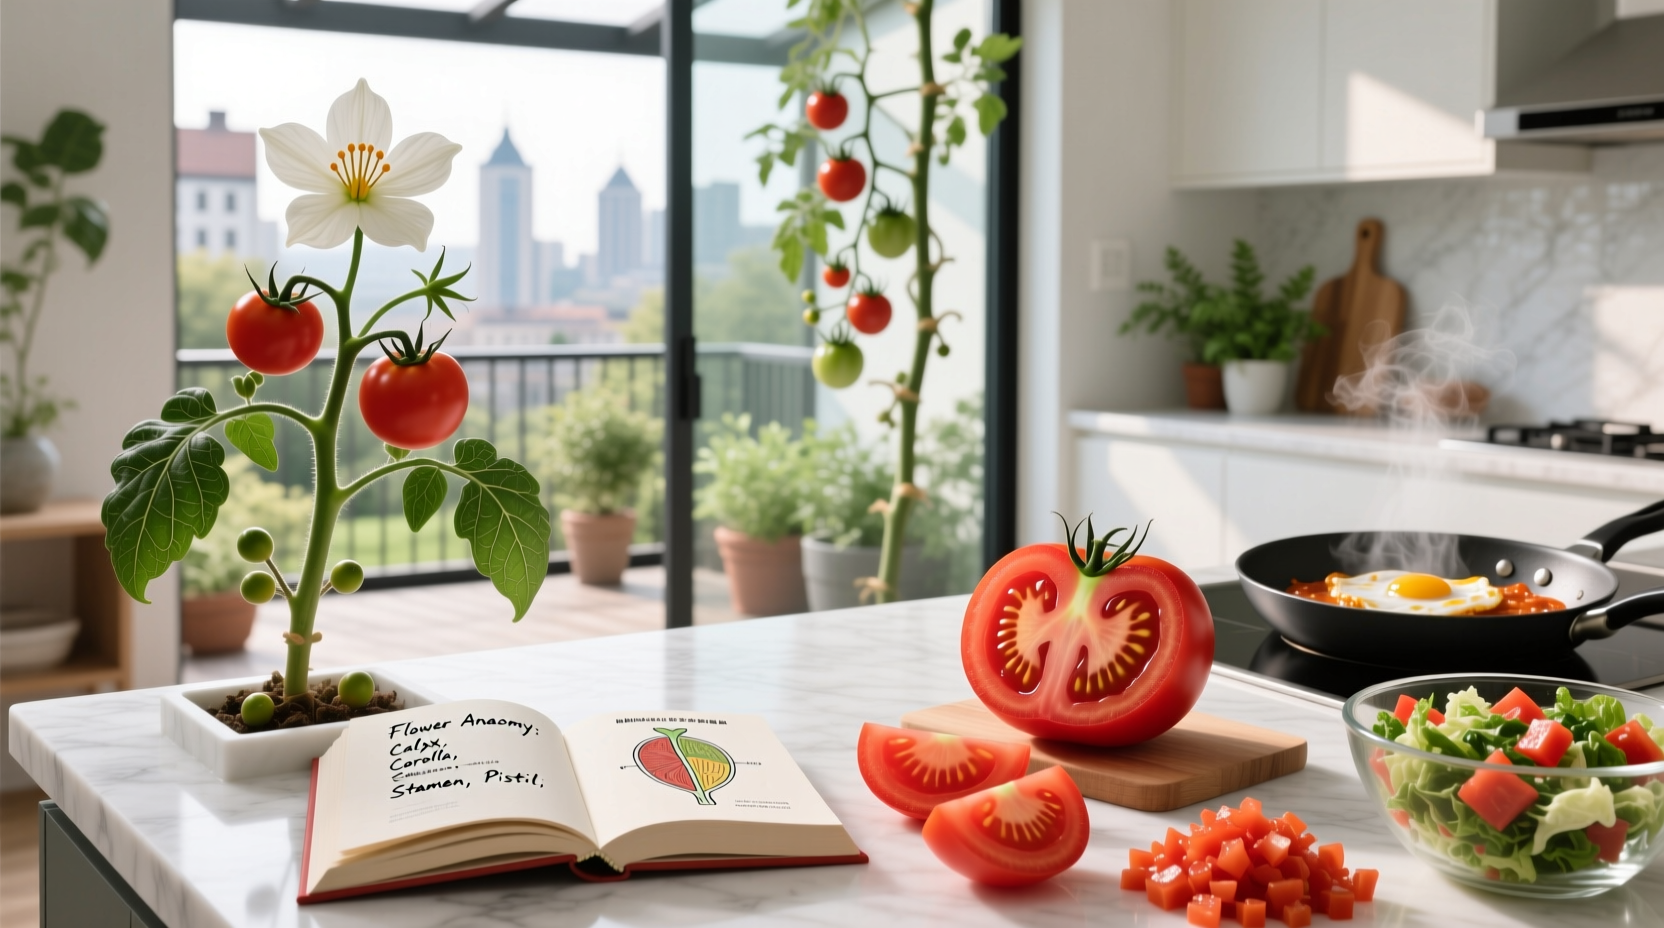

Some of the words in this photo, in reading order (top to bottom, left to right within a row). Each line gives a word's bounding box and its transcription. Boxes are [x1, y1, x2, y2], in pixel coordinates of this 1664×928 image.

[389, 721, 451, 739] Flower
[389, 749, 458, 771] Corolla,
[390, 778, 471, 799] Stamen,
